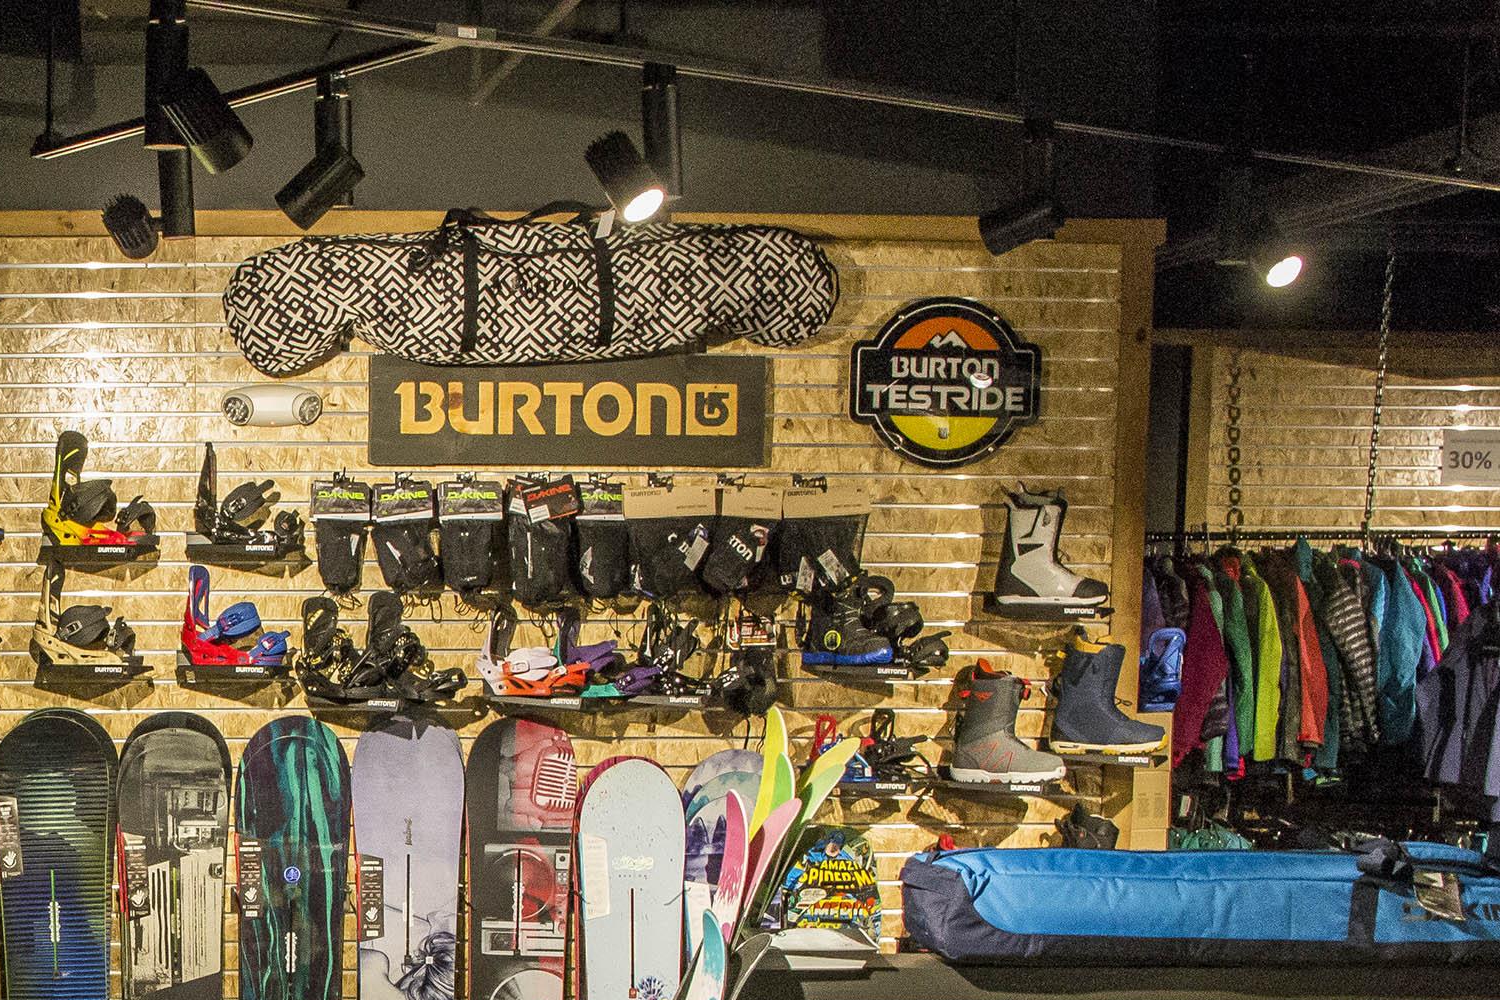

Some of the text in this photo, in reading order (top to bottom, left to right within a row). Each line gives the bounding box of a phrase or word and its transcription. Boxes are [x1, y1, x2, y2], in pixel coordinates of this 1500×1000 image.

[891, 356, 999, 379] BURTON
[866, 384, 1025, 411] TESTRIDE
[394, 381, 683, 436] BURTON
[1449, 450, 1492, 469] 30%
[316, 491, 365, 500] DAKINE
[380, 490, 429, 501] DAKINE
[447, 491, 497, 500] DAKINE
[527, 484, 572, 502] DAKINE
[550, 698, 577, 706] BURTON
